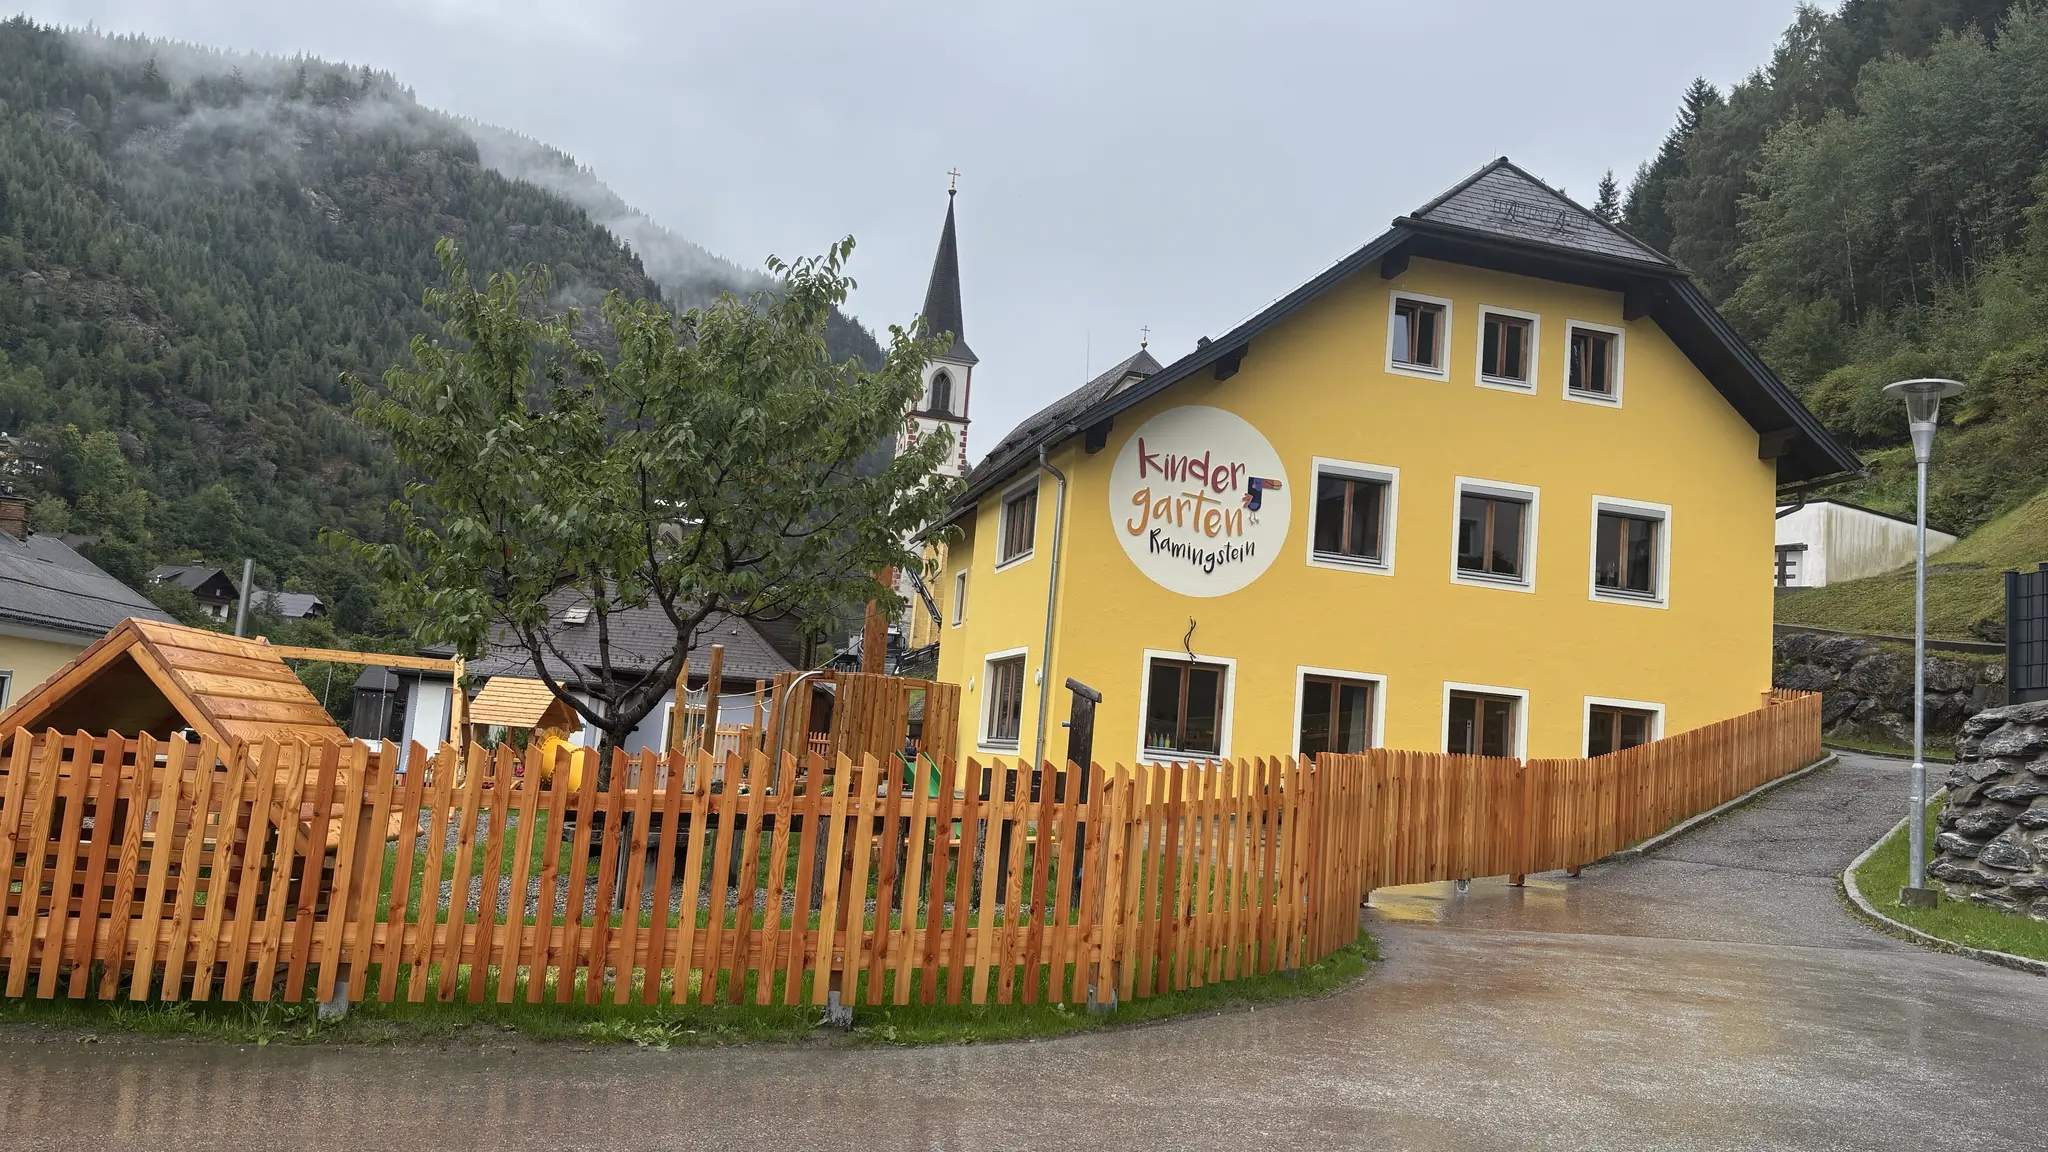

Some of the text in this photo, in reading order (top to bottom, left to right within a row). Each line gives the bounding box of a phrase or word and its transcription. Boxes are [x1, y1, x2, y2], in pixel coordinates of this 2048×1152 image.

[1138, 437, 1246, 494] kinder
[1127, 487, 1243, 537] garten
[1150, 528, 1255, 574] Ramingstein
